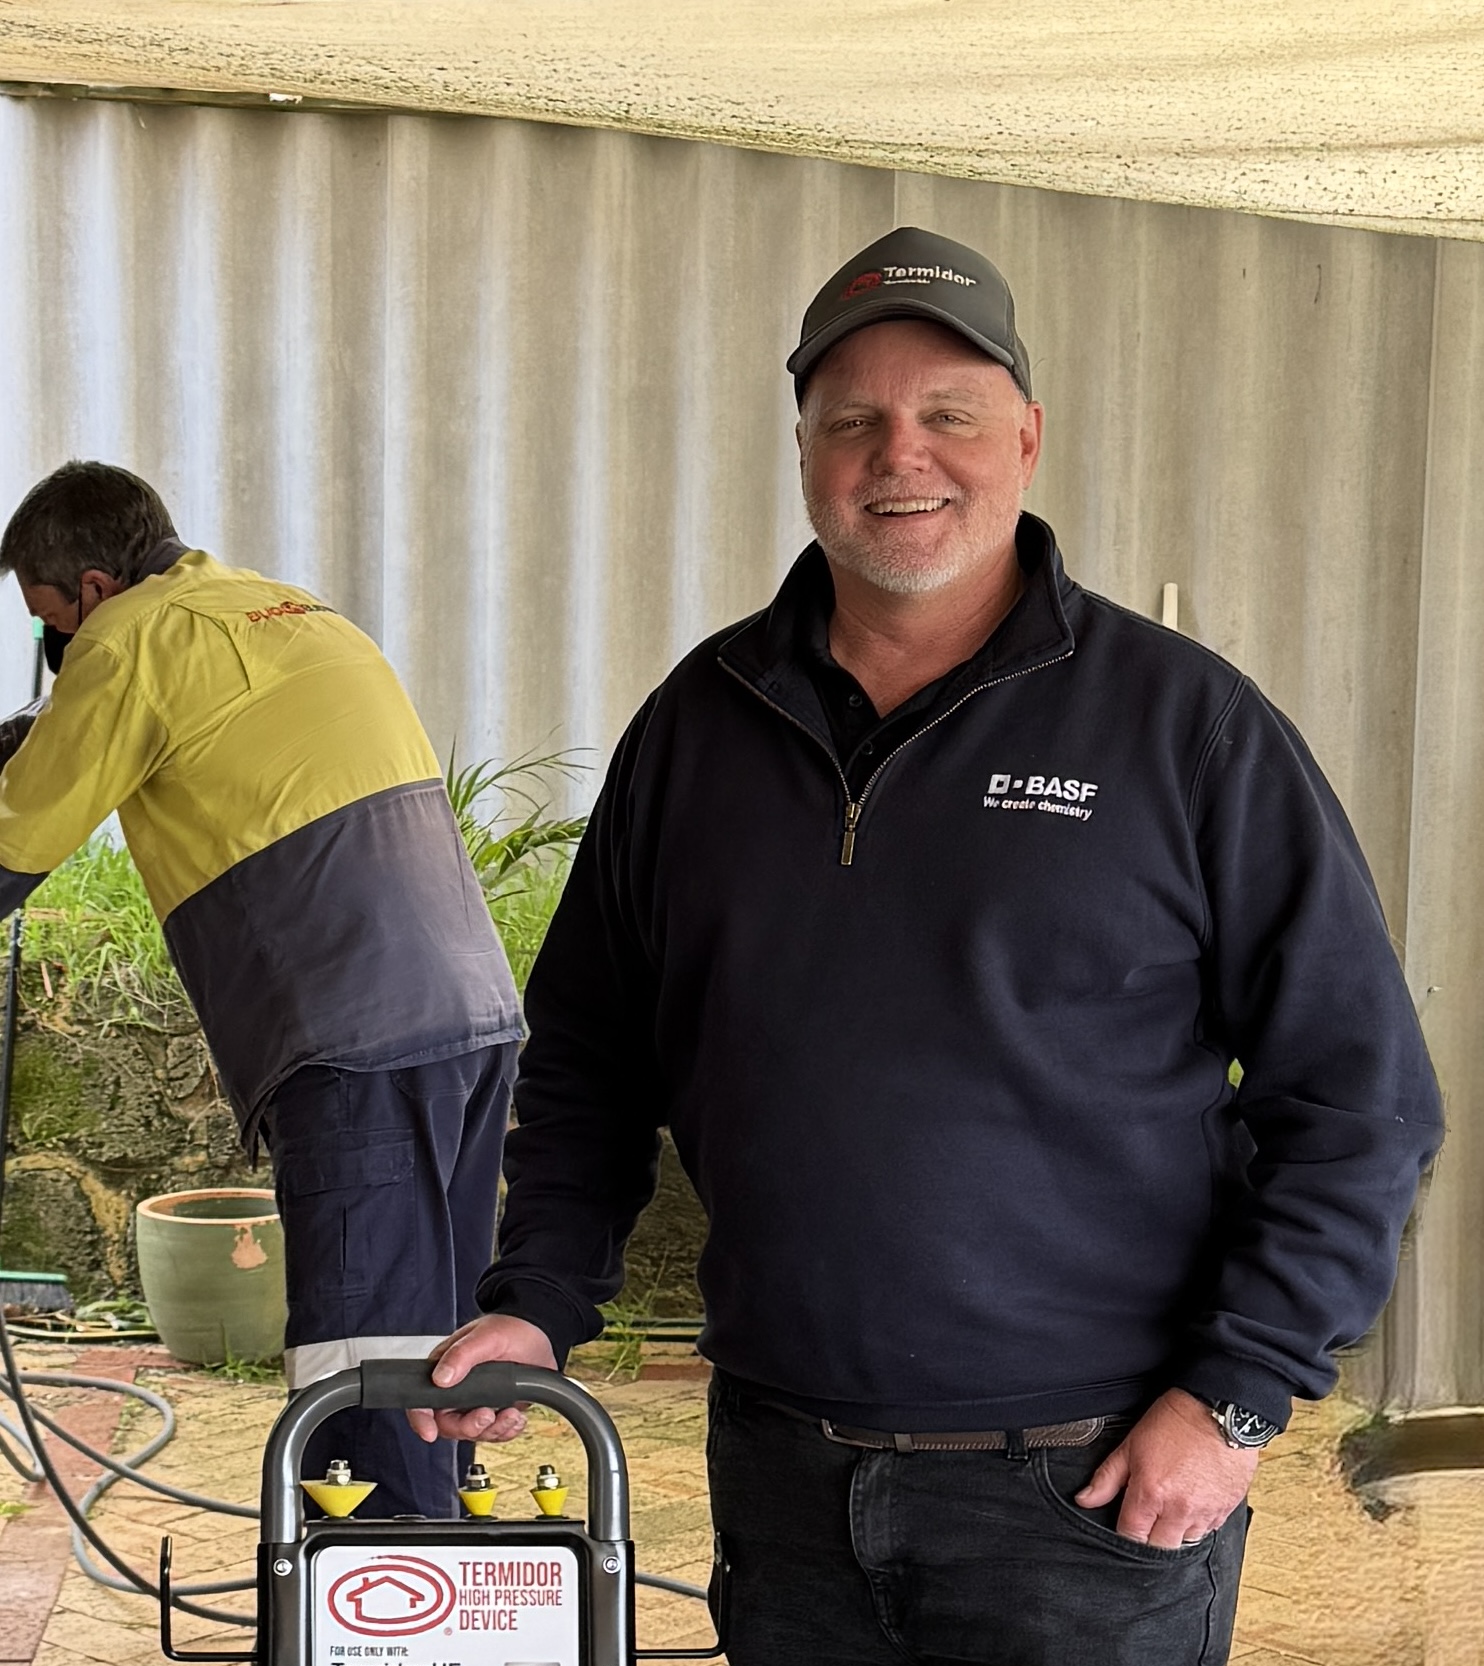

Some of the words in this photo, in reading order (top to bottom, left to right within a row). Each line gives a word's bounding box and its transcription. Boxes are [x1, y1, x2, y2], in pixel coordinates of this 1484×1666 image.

[883, 265, 977, 287] Termidor
[1025, 775, 1099, 803] BASF
[983, 795, 1000, 808] We
[1001, 799, 1036, 809] create
[1037, 800, 1092, 821] chemistry
[458, 1561, 563, 1587] TERMIDOR
[459, 1589, 491, 1606] HIGH
[494, 1589, 563, 1606] PRESSURE
[459, 1609, 519, 1631] DEVICE
[330, 1646, 345, 1656] FOR
[347, 1646, 362, 1657] USE
[364, 1646, 384, 1657] ONLY
